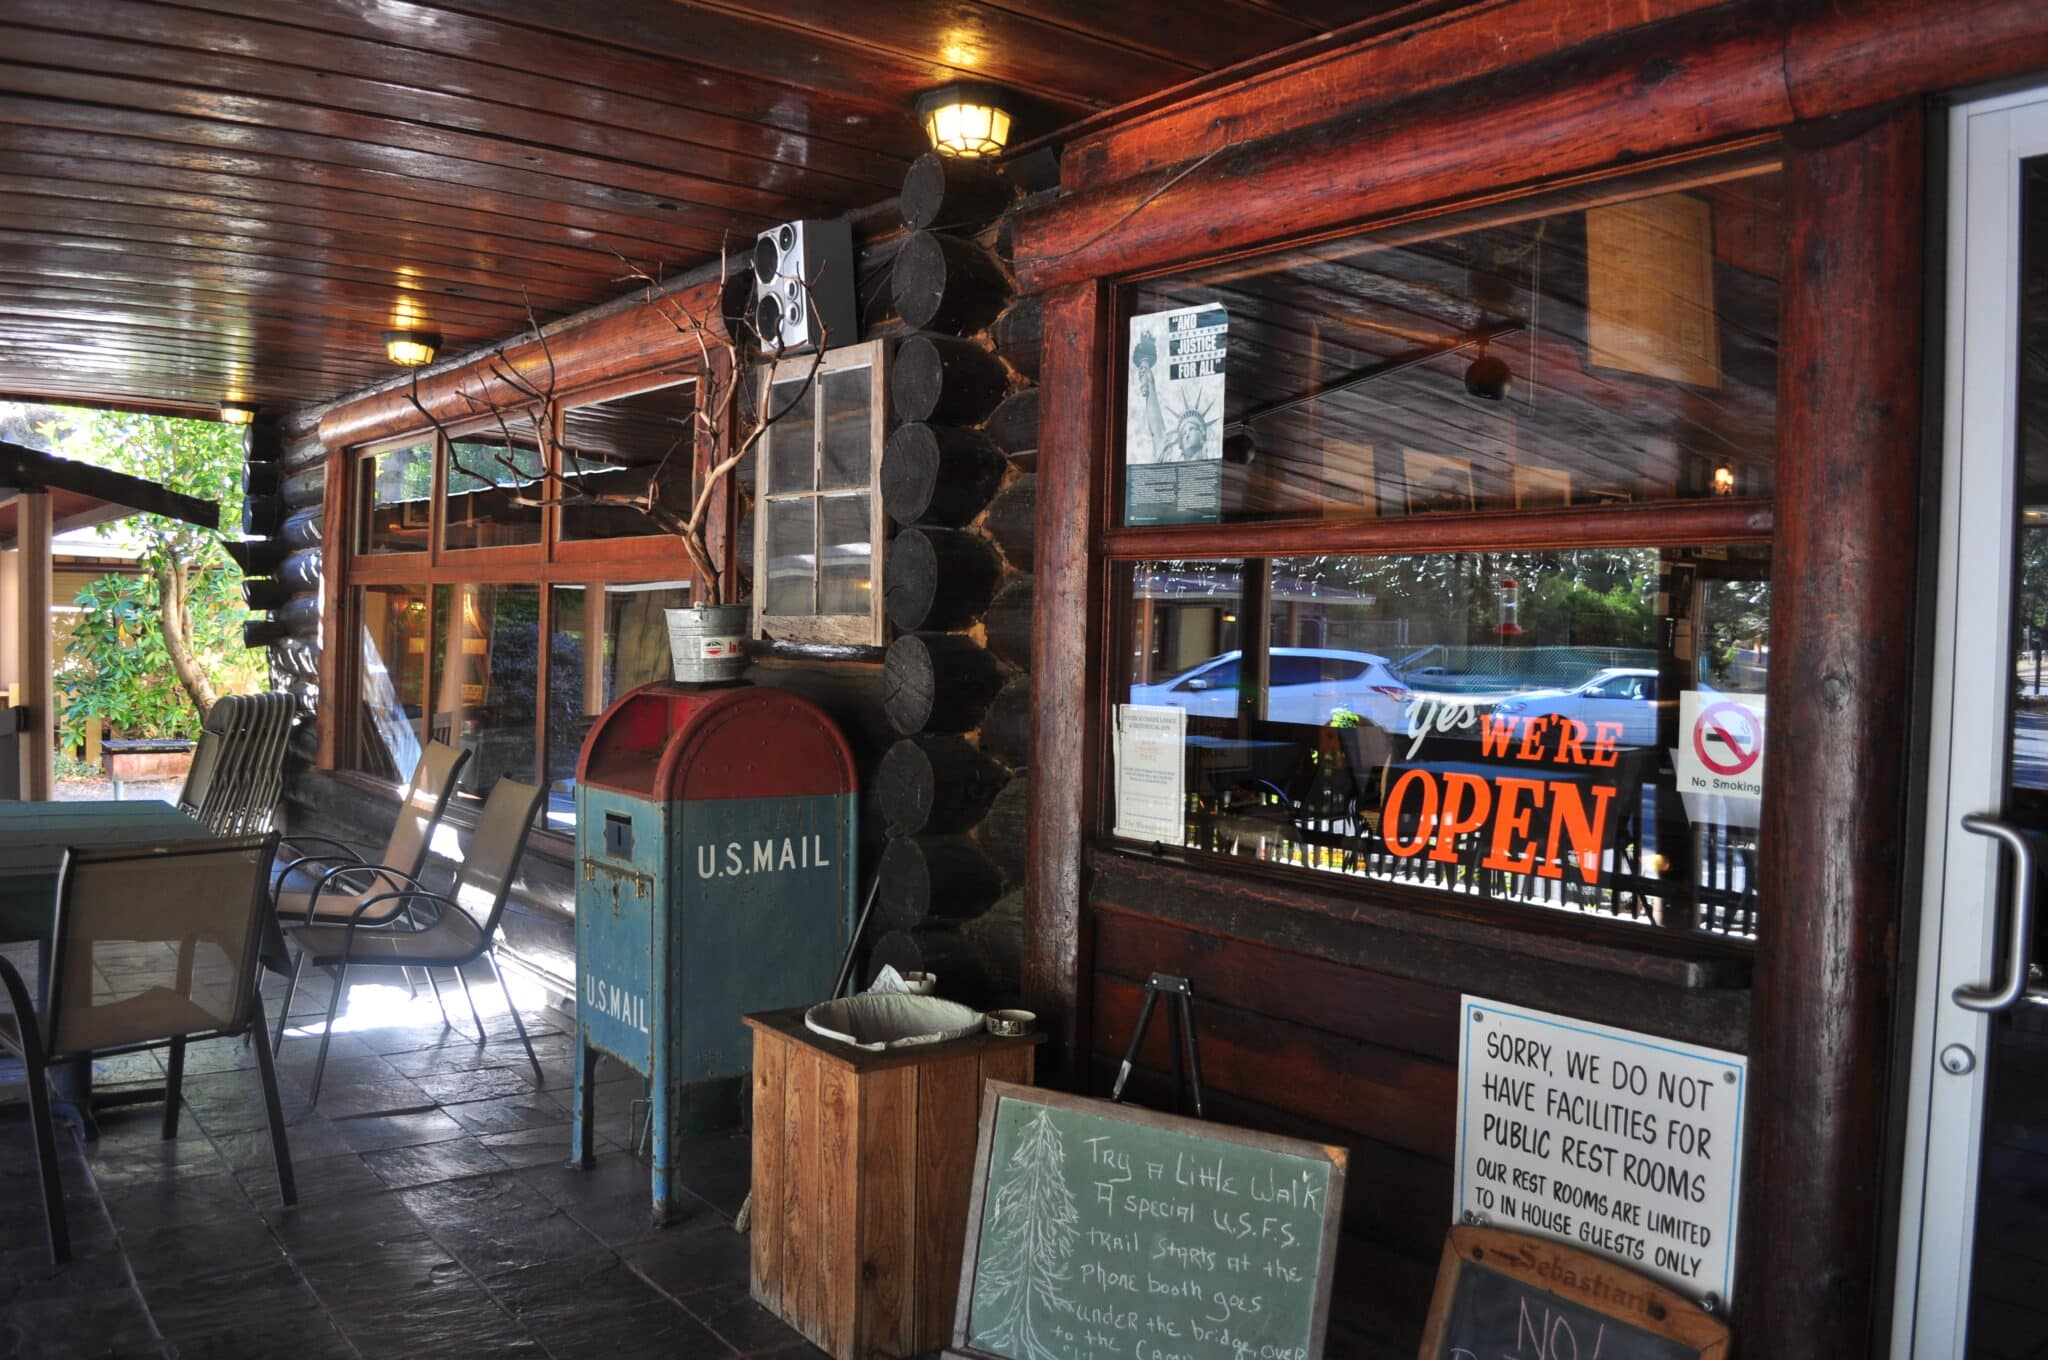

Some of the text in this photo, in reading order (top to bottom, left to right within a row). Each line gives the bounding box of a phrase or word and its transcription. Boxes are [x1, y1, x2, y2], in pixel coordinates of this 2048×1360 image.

[1177, 334, 1217, 355] JUSTICE
[1178, 361, 1197, 379] FOR
[1479, 712, 1623, 767] WE'RE
[1691, 776, 1761, 795] No Smoking
[1382, 769, 1617, 885] OPEN
[1567, 1049, 1600, 1085] WE
[1612, 1060, 1648, 1096] DO
[1658, 1071, 1713, 1112] NOT
[1482, 1072, 1712, 1160] HAVE FACILITIES FOR
[1145, 1162, 1164, 1180] A
[1483, 1113, 1705, 1202] PUBLIC REST ROOMS
[1094, 1181, 1113, 1217] A
[1476, 1157, 1711, 1248] OUR REST ROOMS ARE LIMITED
[1475, 1186, 1702, 1278] TO IN HOUSE GUESTS ONLY
[1263, 1258, 1303, 1283] the
[1147, 1272, 1202, 1301] booth
[1206, 1291, 1262, 1322] goes
[1051, 1325, 1074, 1341] to
[1084, 1329, 1121, 1351] the
[1146, 1315, 1181, 1337] the
